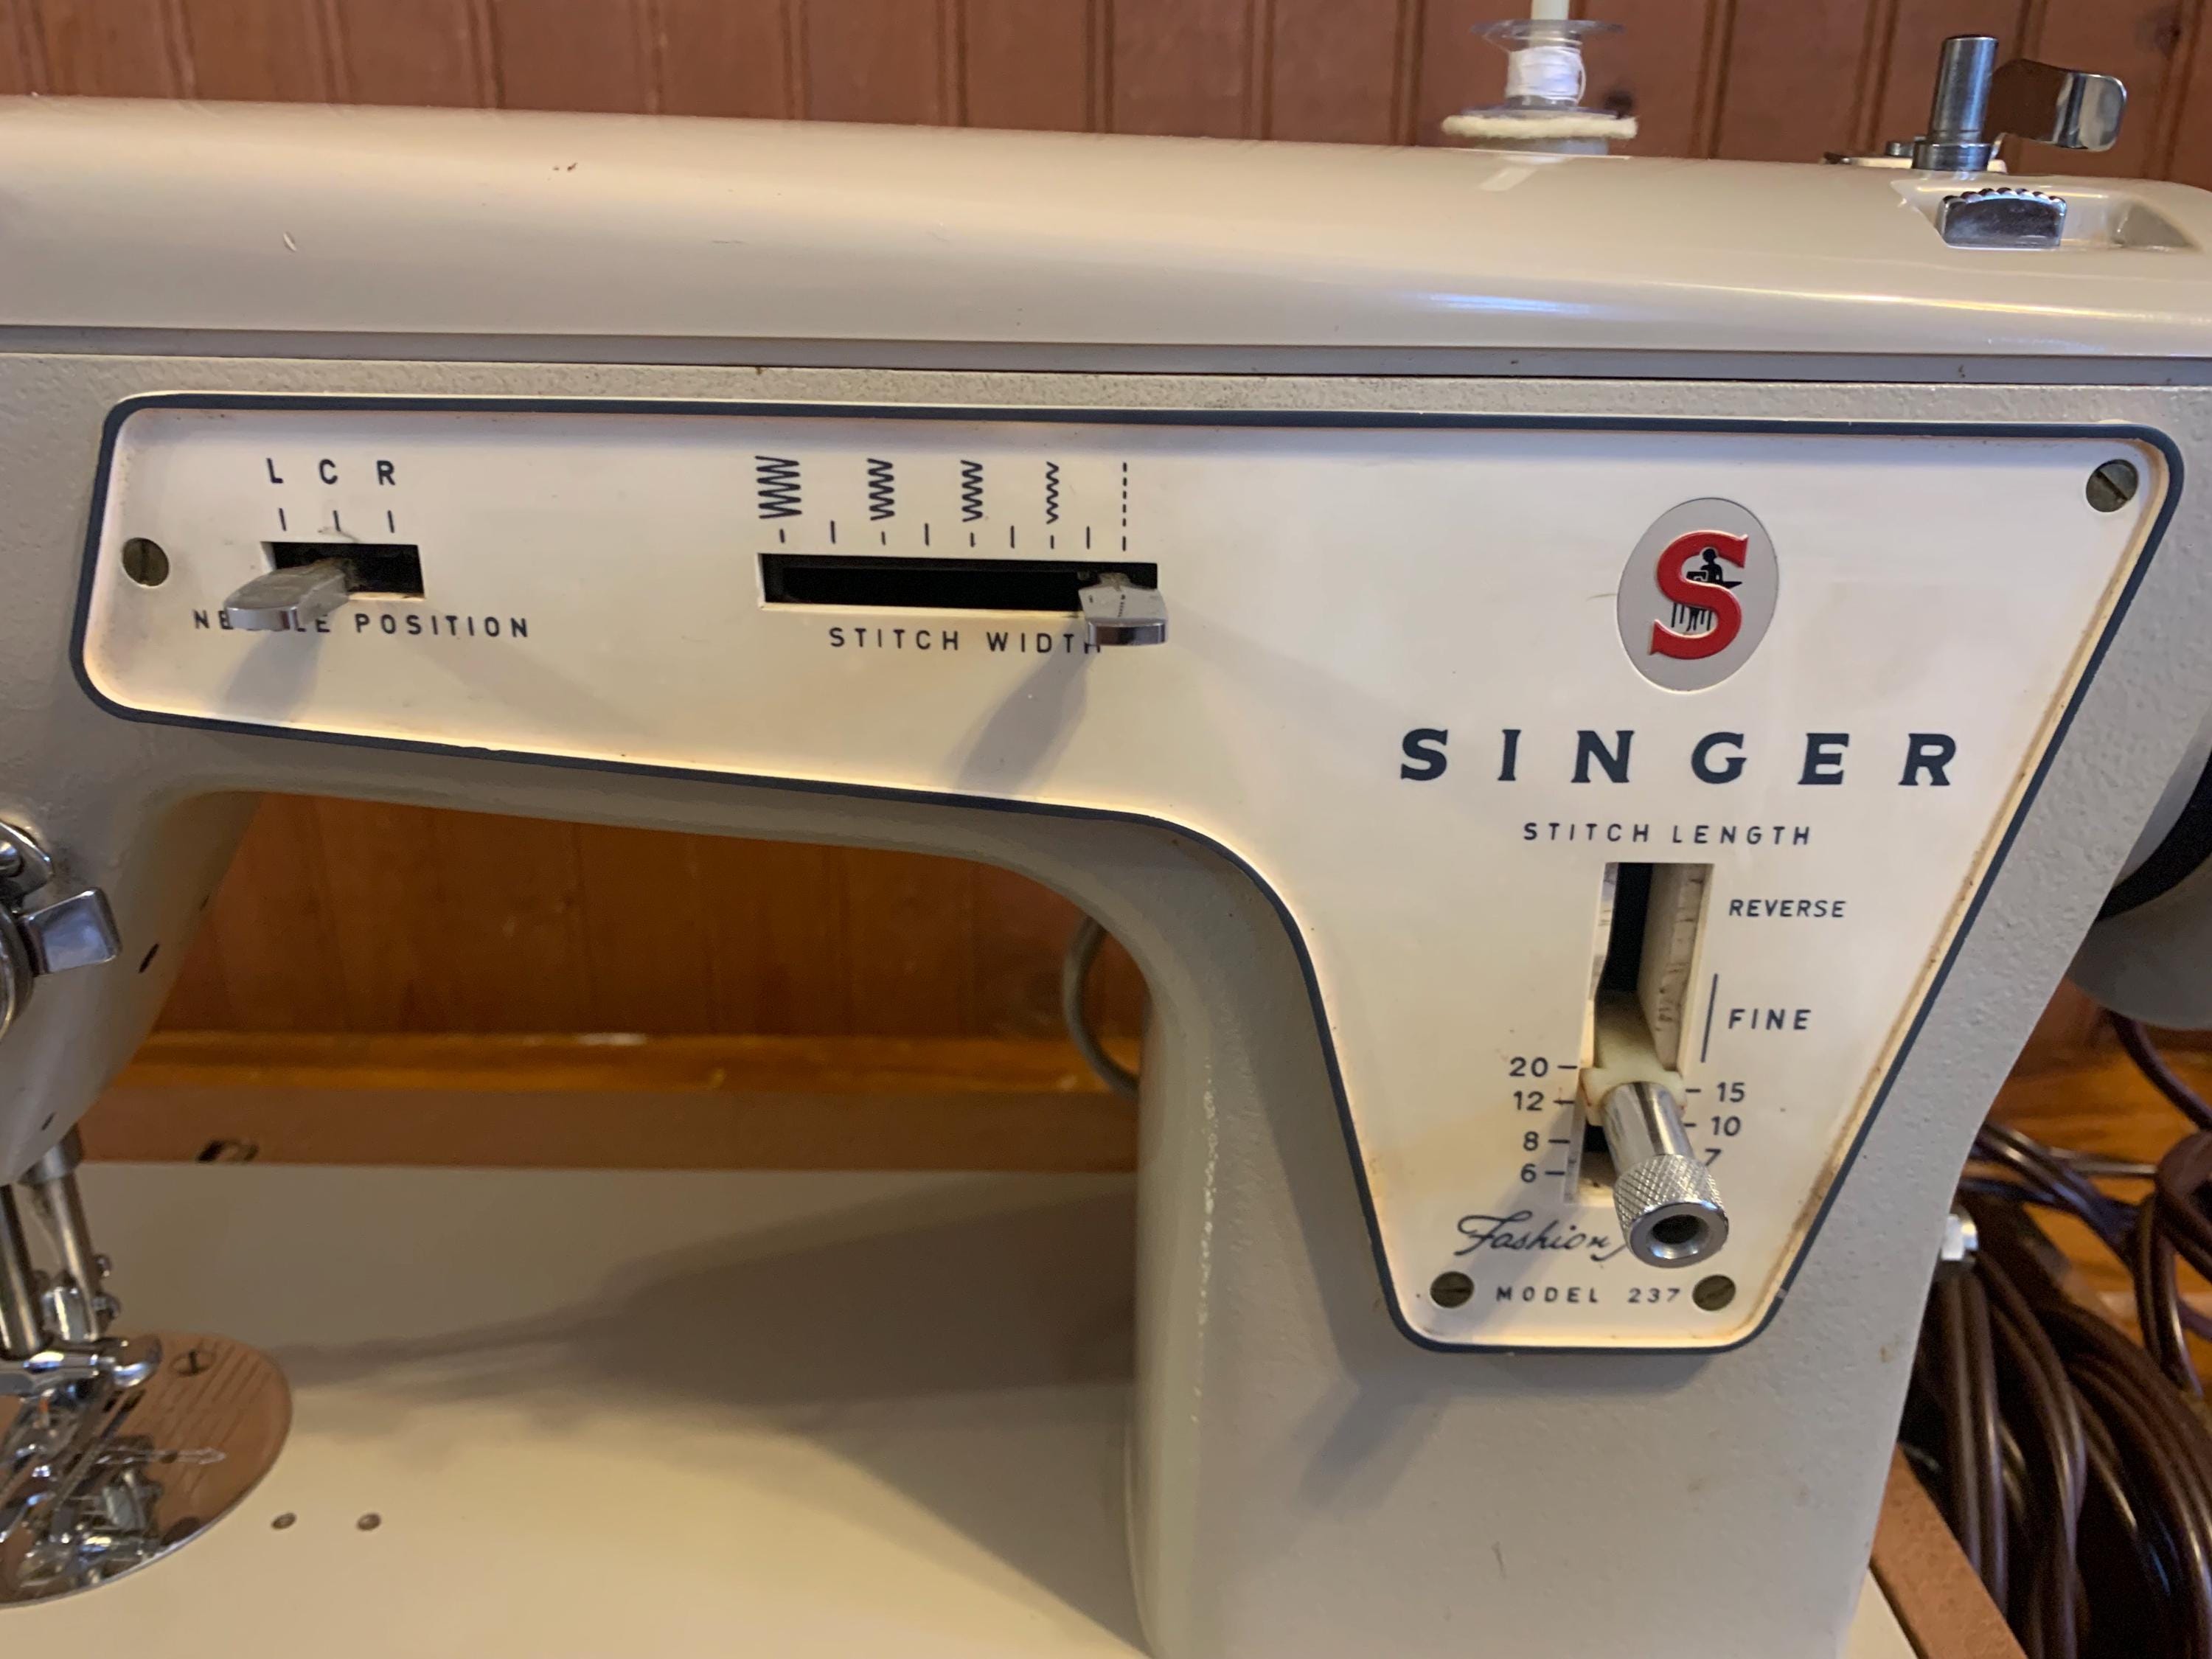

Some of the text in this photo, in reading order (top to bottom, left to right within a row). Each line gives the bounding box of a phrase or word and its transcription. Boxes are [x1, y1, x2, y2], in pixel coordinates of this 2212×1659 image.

[265, 457, 396, 486] L C R
[1647, 530, 1749, 660] S
[192, 610, 528, 638] NELE POSITION
[829, 626, 959, 651] STITCH
[1399, 727, 1957, 787] SINGER
[1523, 821, 1810, 846] STITCH LENGTH
[1728, 898, 1846, 918] REVERSE
[1728, 1008, 1812, 1031] FINE
[1509, 1056, 1549, 1079] 20
[1513, 1090, 1545, 1112] 12
[1717, 1081, 1745, 1104] 15
[1711, 1115, 1742, 1137] 10
[1523, 1130, 1540, 1152] 8
[1520, 1163, 1538, 1184] 6
[1453, 1209, 1612, 1256] Fashion
[1495, 1287, 1681, 1304] MODEL 237
